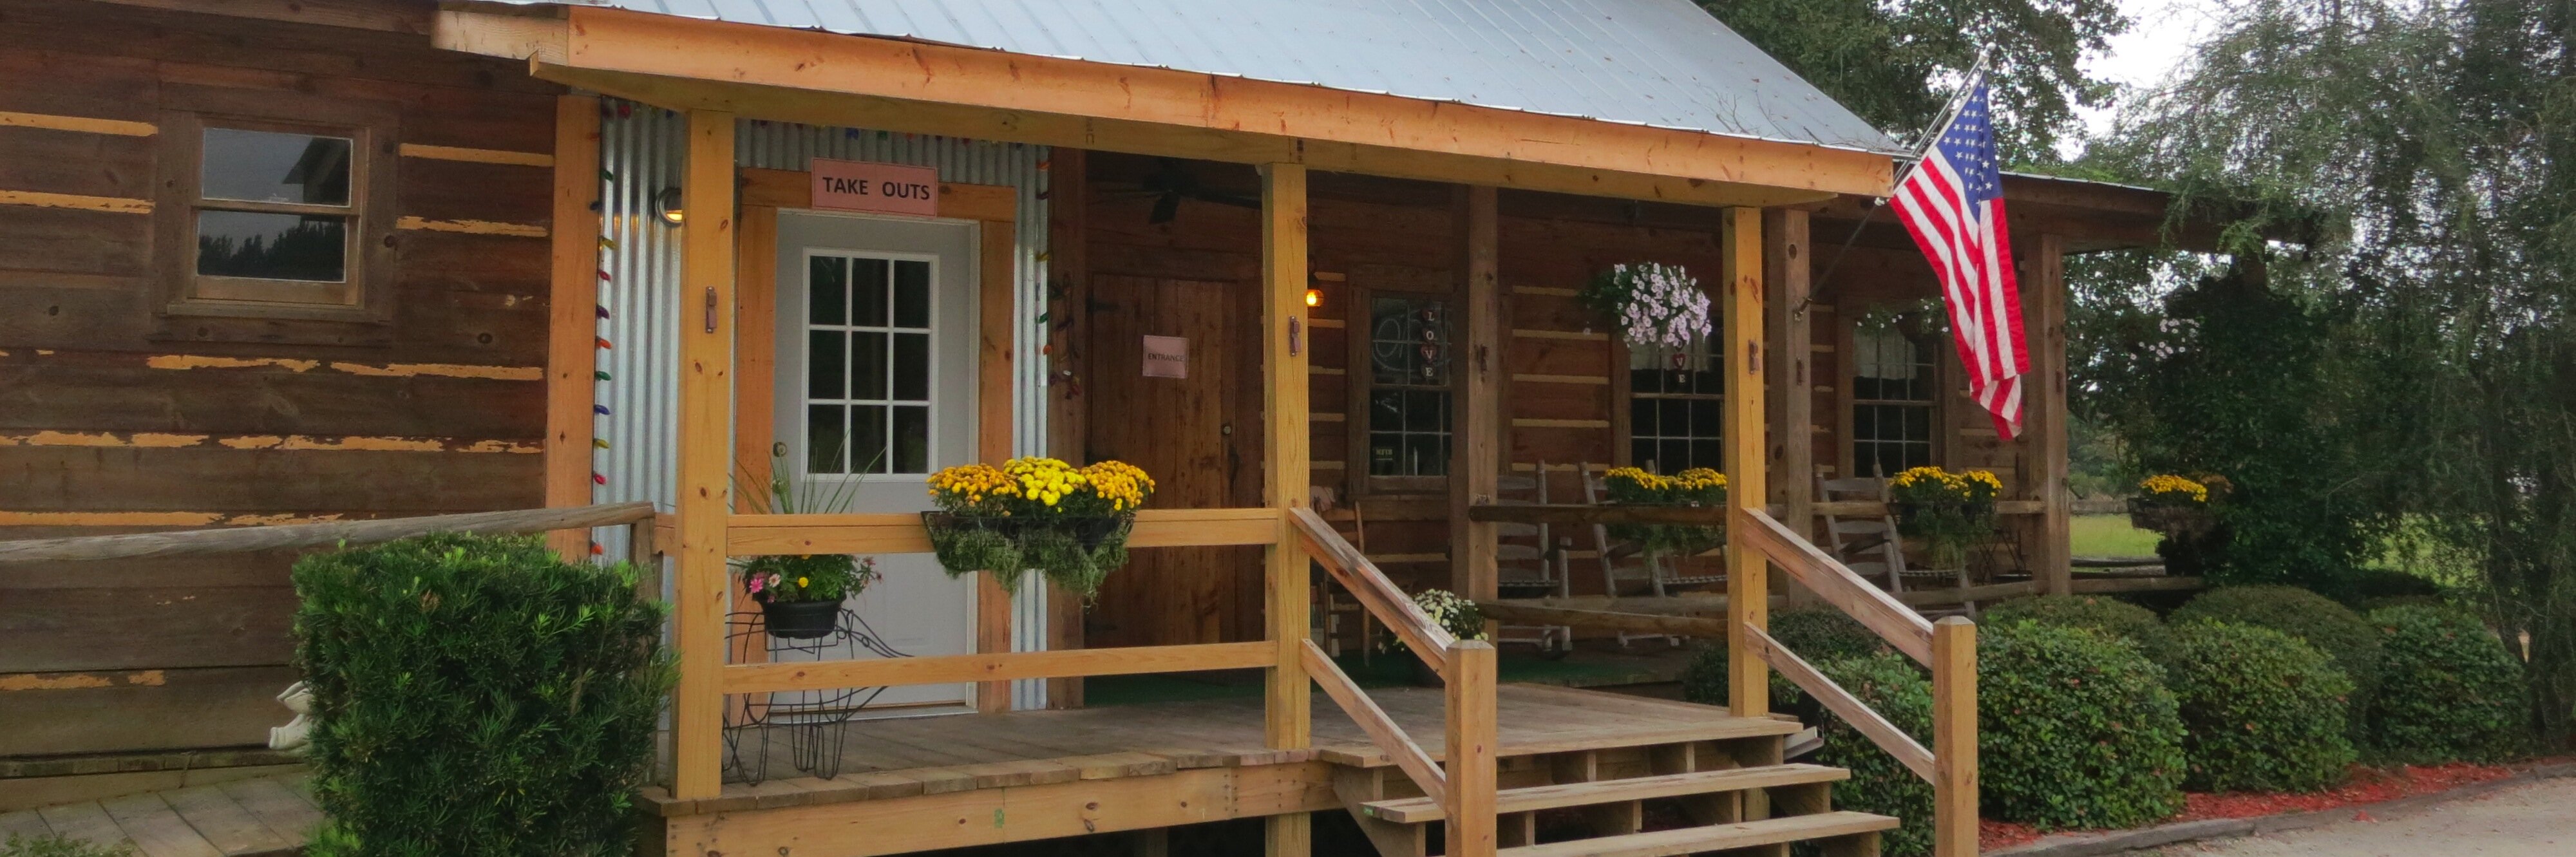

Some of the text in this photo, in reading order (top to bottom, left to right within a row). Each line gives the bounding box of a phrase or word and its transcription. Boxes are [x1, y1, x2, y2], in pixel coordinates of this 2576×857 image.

[822, 176, 930, 200] TAKE OUTS
[1425, 311, 1435, 377] LOVE
[1148, 353, 1184, 362] ENTRANCE
